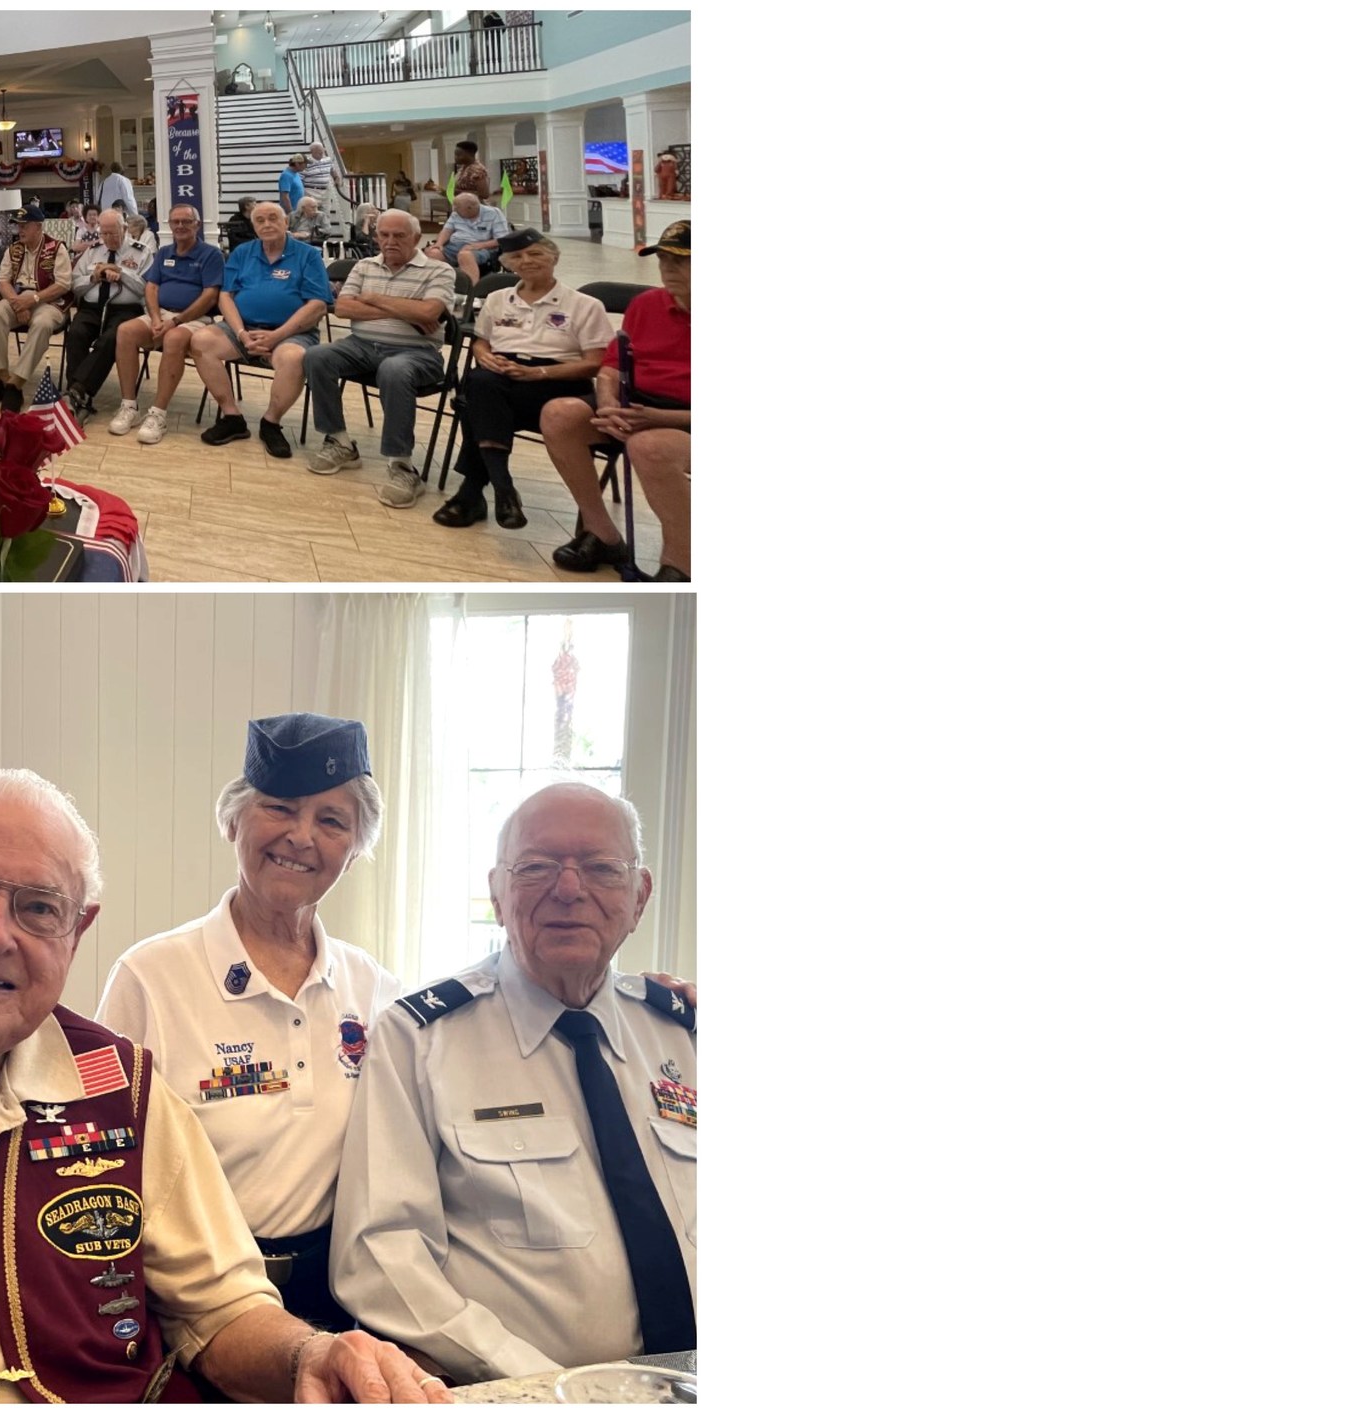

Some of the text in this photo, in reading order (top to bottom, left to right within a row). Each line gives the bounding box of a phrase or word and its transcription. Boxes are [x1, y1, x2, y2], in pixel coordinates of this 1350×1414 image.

[169, 127, 200, 139] Because
[172, 140, 198, 160] of the
[215, 1042, 254, 1056] Nancy
[223, 1055, 252, 1067] USAF
[45, 1195, 139, 1227] SEADRAGON BASE
[75, 1239, 132, 1254] SUB VETS
